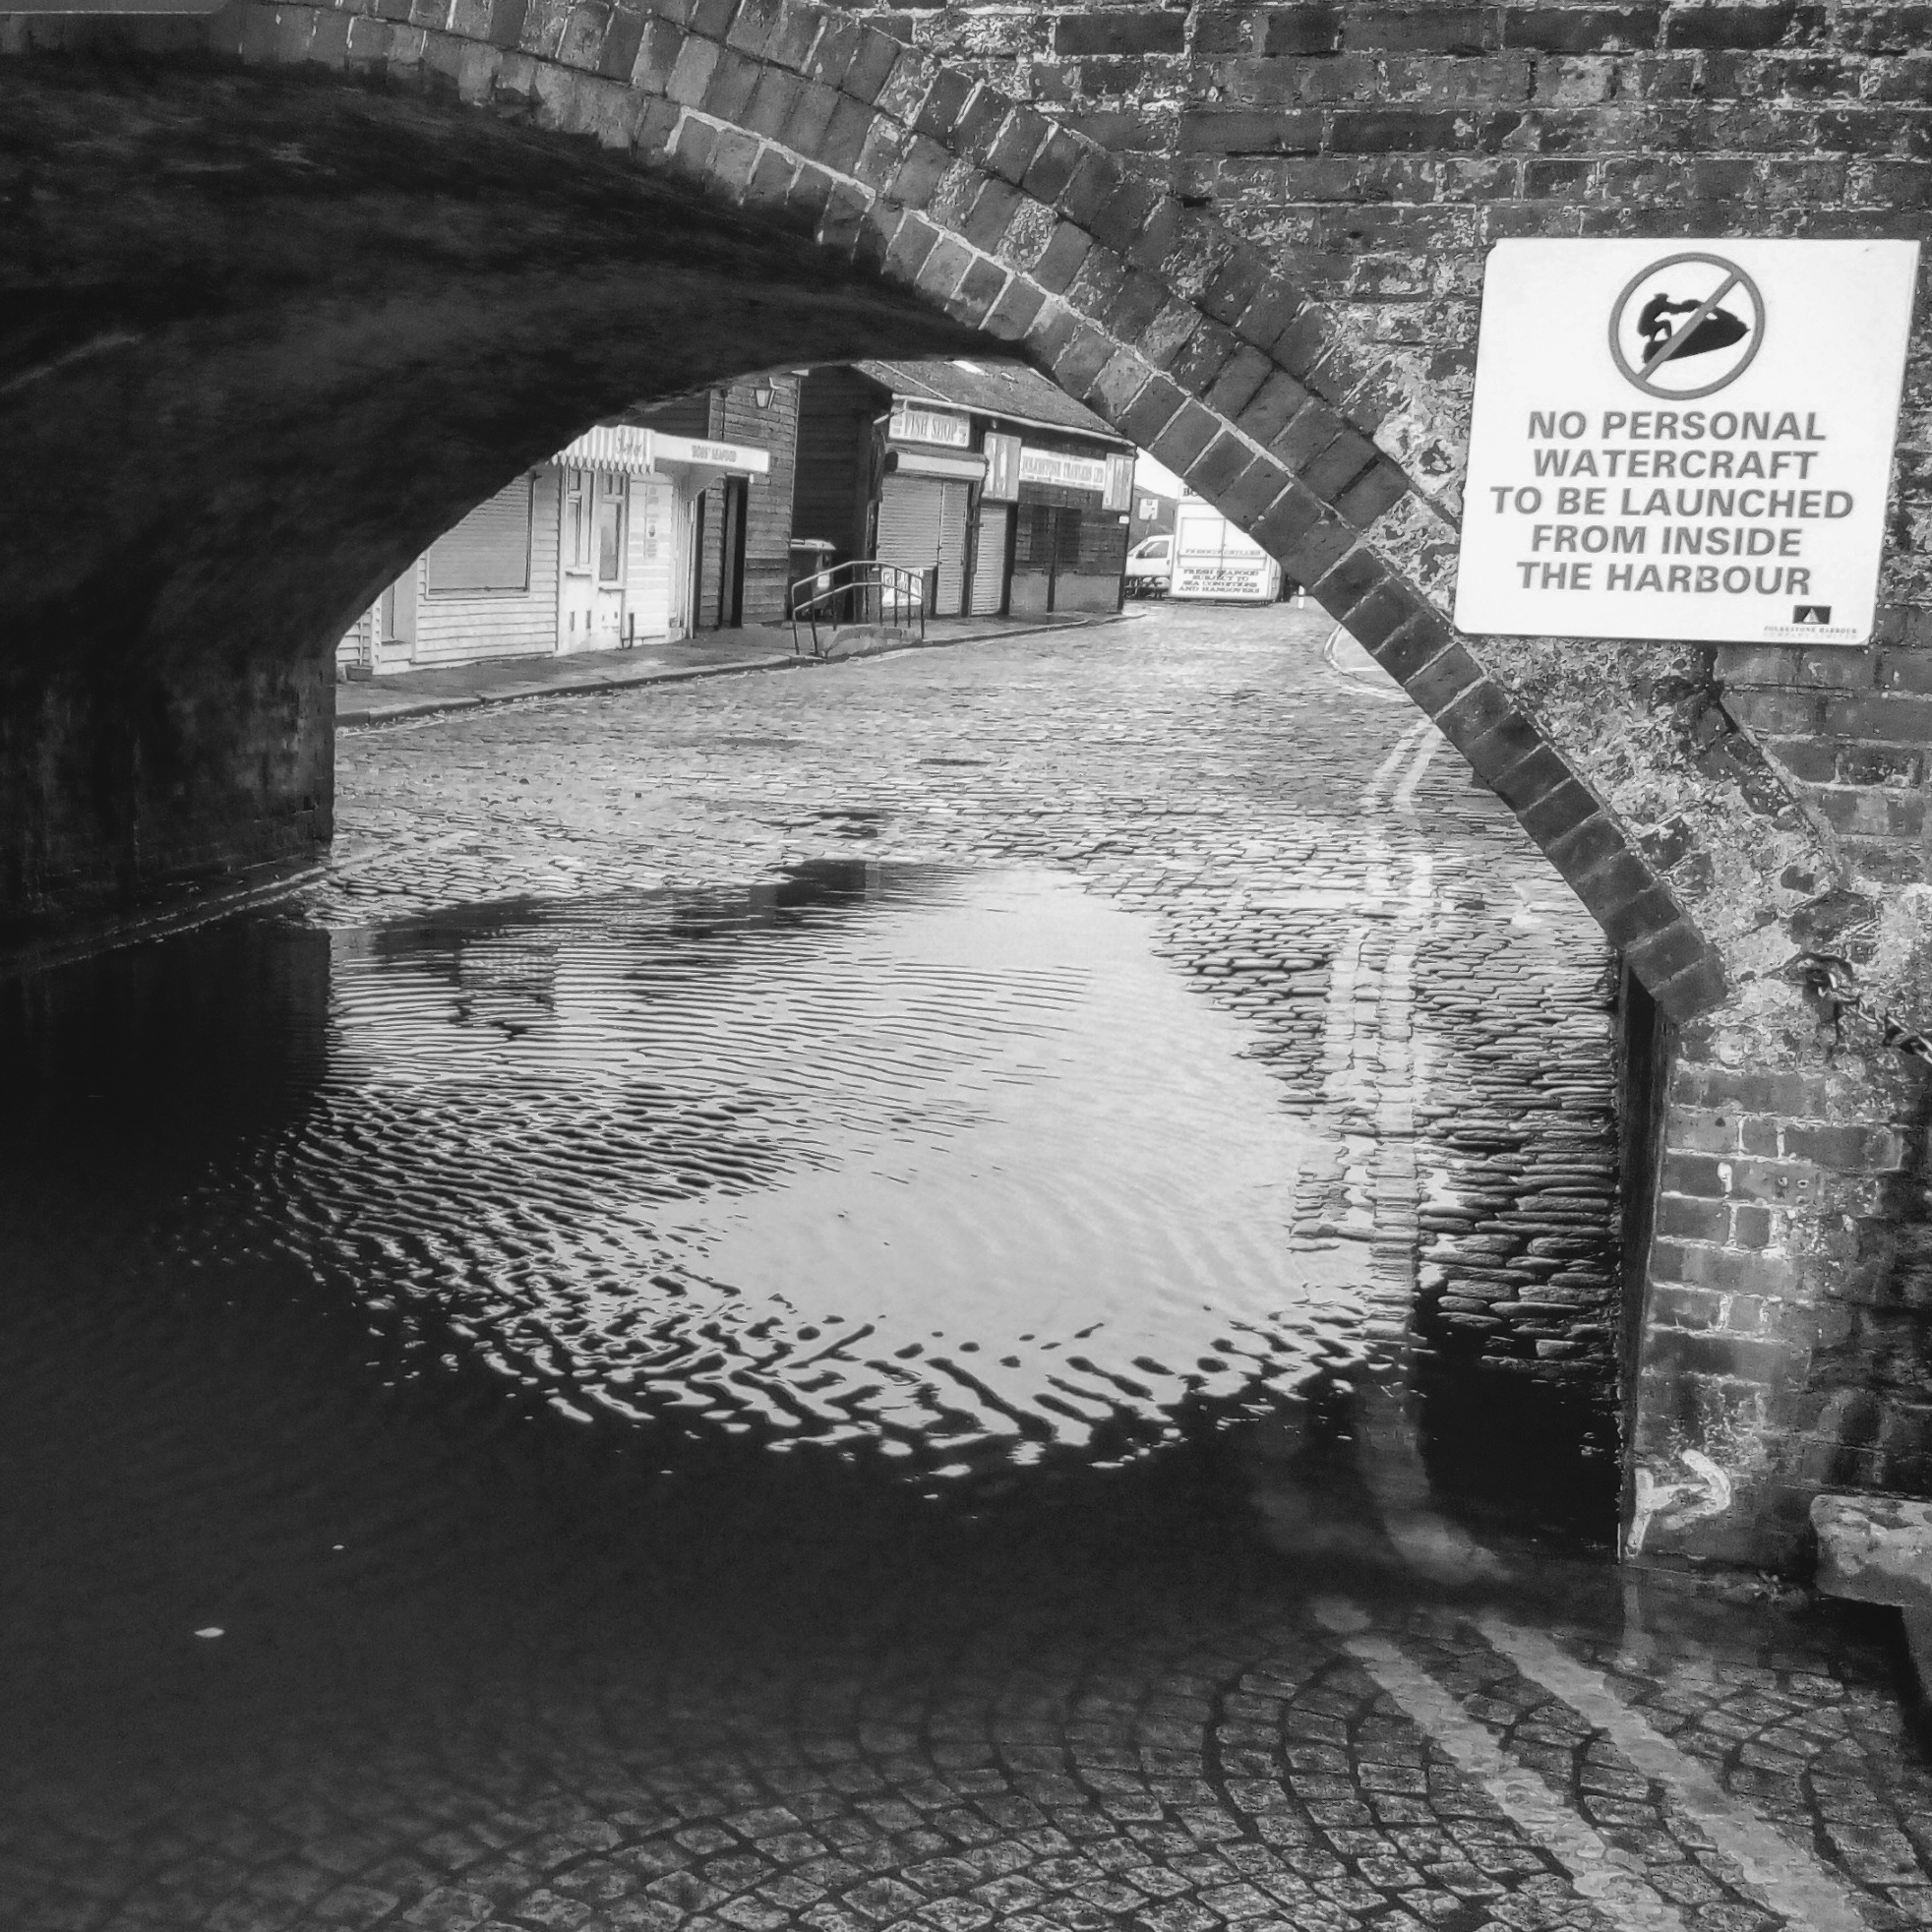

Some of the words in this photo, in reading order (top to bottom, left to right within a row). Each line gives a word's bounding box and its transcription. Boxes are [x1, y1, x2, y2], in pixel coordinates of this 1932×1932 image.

[904, 413, 929, 439] FISH
[932, 416, 957, 442] SHOP
[1528, 411, 1587, 440] NO
[1601, 411, 1827, 442] PERSONAL
[1534, 449, 1819, 480] WATERCRAFT
[1490, 486, 1542, 514] TO
[1557, 487, 1606, 515] BE
[1620, 488, 1853, 519] LAUNCHED
[1532, 524, 1647, 554] FROM
[1661, 526, 1802, 557] INSIDE
[1517, 561, 1593, 590] THE
[1606, 563, 1811, 596] HARBOUR
